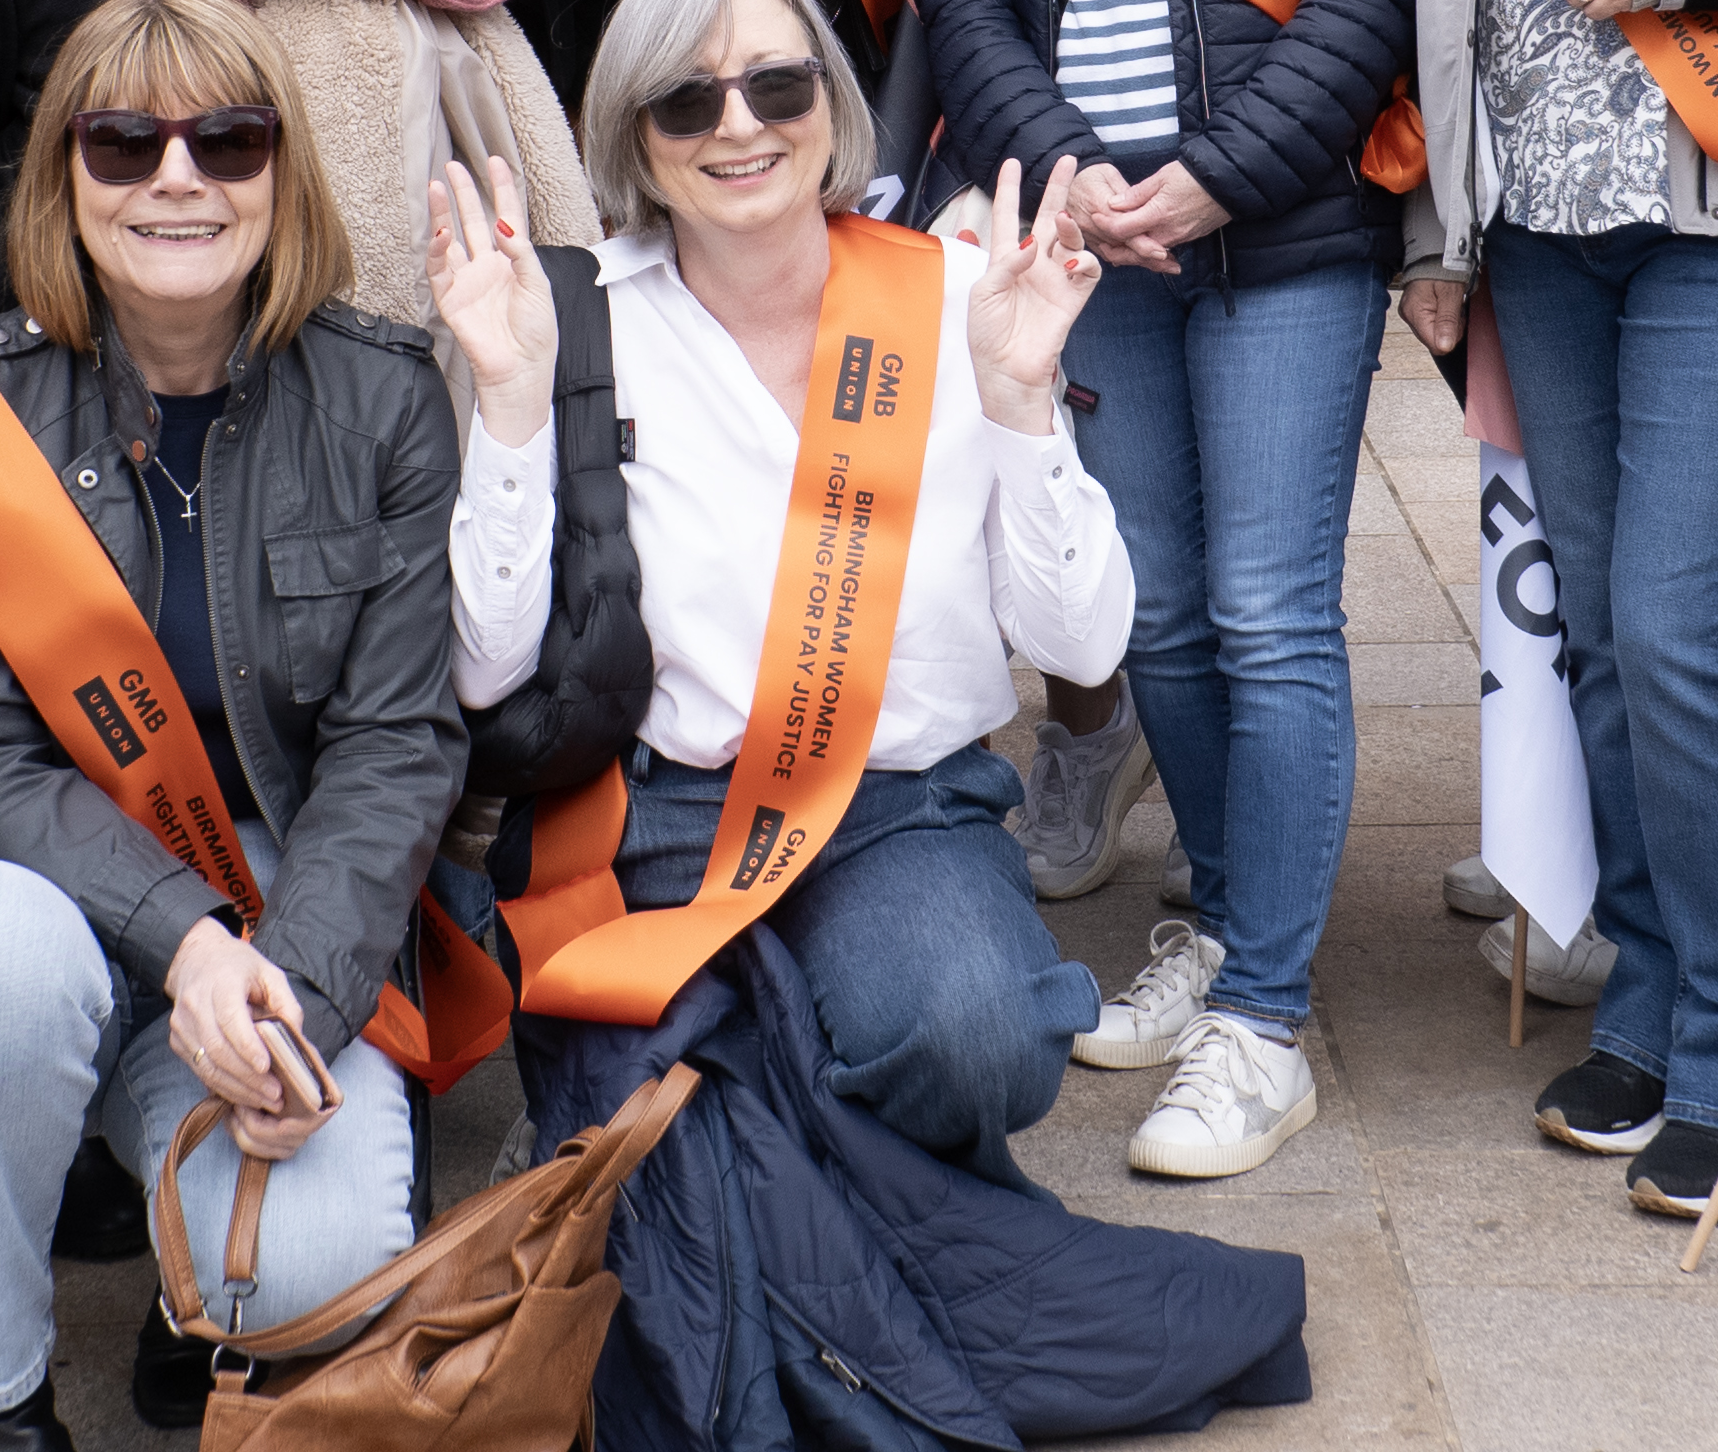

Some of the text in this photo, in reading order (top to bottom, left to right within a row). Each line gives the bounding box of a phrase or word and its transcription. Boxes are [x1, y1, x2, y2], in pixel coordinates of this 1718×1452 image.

[843, 348, 863, 411] UNION
[873, 353, 904, 417] GMB
[772, 452, 850, 781] FIGHTING FOR PAY JUSTICE
[809, 490, 874, 759] BIRMINGHAM WOMEN
[89, 692, 132, 754] UNION
[119, 669, 168, 734] GMB
[741, 820, 772, 882] UNION
[762, 828, 806, 884] GMB
